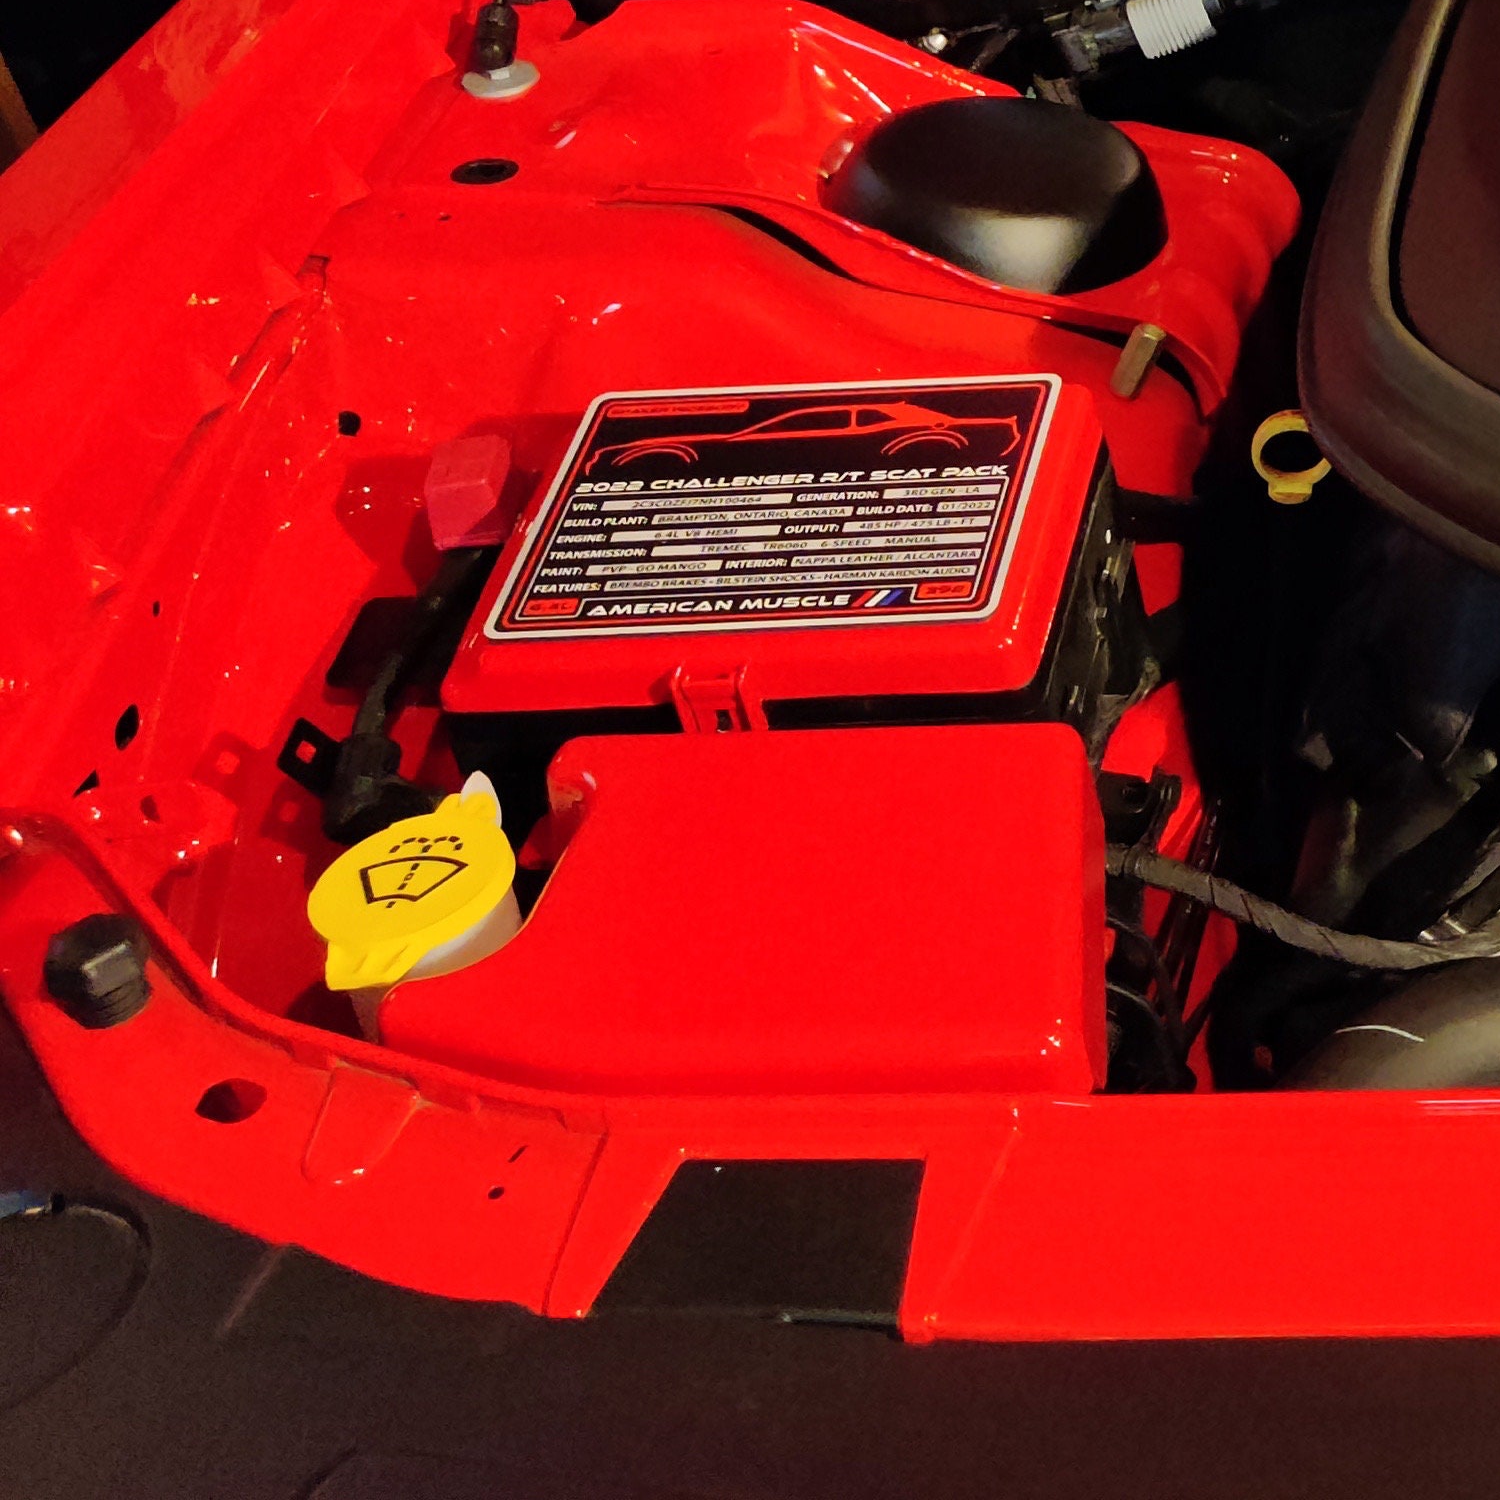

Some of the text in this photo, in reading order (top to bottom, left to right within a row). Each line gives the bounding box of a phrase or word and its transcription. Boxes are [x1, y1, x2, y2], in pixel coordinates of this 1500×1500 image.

[576, 465, 1009, 493] 2022 CHALLENGER R/T SCAT PACK
[796, 490, 880, 502] GENERATION:
[902, 487, 928, 497] 3RD
[930, 486, 956, 496] GEN
[964, 485, 980, 495] LA
[571, 502, 598, 512] VIN:
[855, 501, 991, 516] BUILD DATE: 01/2022
[563, 518, 602, 528] BUILD
[603, 515, 649, 527] PLANT:
[793, 507, 846, 517] CANADA
[784, 523, 840, 534] OUTPUT:
[859, 522, 881, 531] 485
[884, 521, 901, 530] HP
[910, 519, 934, 529] 475
[936, 518, 951, 528] LB
[556, 534, 607, 544] ENGINE:
[685, 529, 702, 538] V8
[706, 528, 739, 537] HEMI
[549, 547, 647, 560] TRANSMISSION:
[700, 543, 750, 553] TREMEC
[883, 535, 938, 546] MANUAL
[725, 557, 788, 569] INTERIOR:
[794, 556, 836, 566] NAPPA
[839, 553, 894, 564] LEATHER
[903, 549, 977, 560] ALCANTARA
[540, 567, 584, 577] PAINT:
[601, 565, 628, 573] PVP
[636, 563, 655, 573] GO
[658, 561, 707, 571] MANGO
[533, 582, 602, 593] FEATURES:
[609, 579, 661, 590] BREMBO
[662, 578, 706, 587] BRAKES
[716, 575, 767, 585] BILSTEIN
[769, 573, 815, 583] SHOCKS
[823, 571, 877, 580] HARMAN
[878, 567, 930, 578] KARDON
[931, 565, 971, 575] AUDIO
[586, 593, 852, 617] AMERICAN MUSCLE
